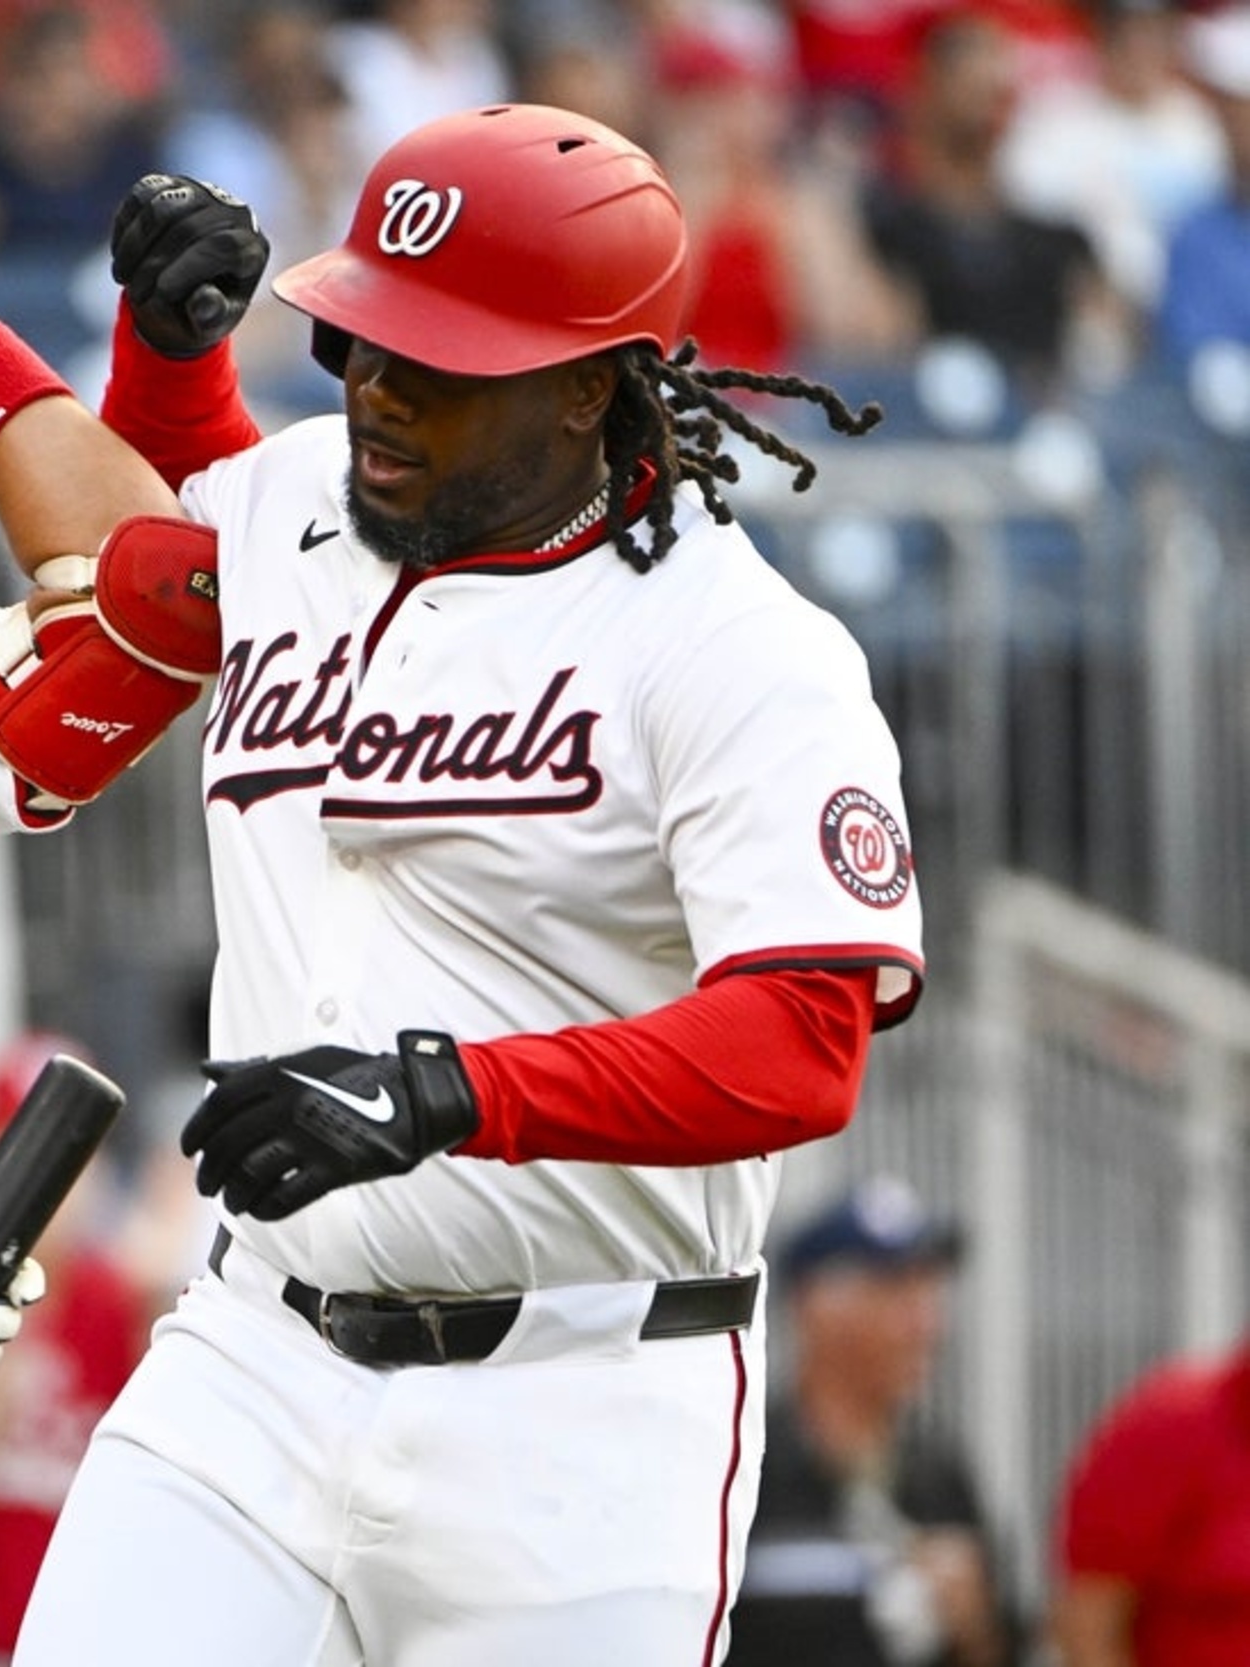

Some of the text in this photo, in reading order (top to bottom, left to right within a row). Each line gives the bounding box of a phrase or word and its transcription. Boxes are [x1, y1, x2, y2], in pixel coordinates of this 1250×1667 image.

[378, 178, 463, 257] W
[61, 711, 135, 744] Lowe
[203, 631, 603, 788] Nationals
[824, 790, 903, 846] WASHINGTON
[833, 858, 907, 904] NATIONALS
